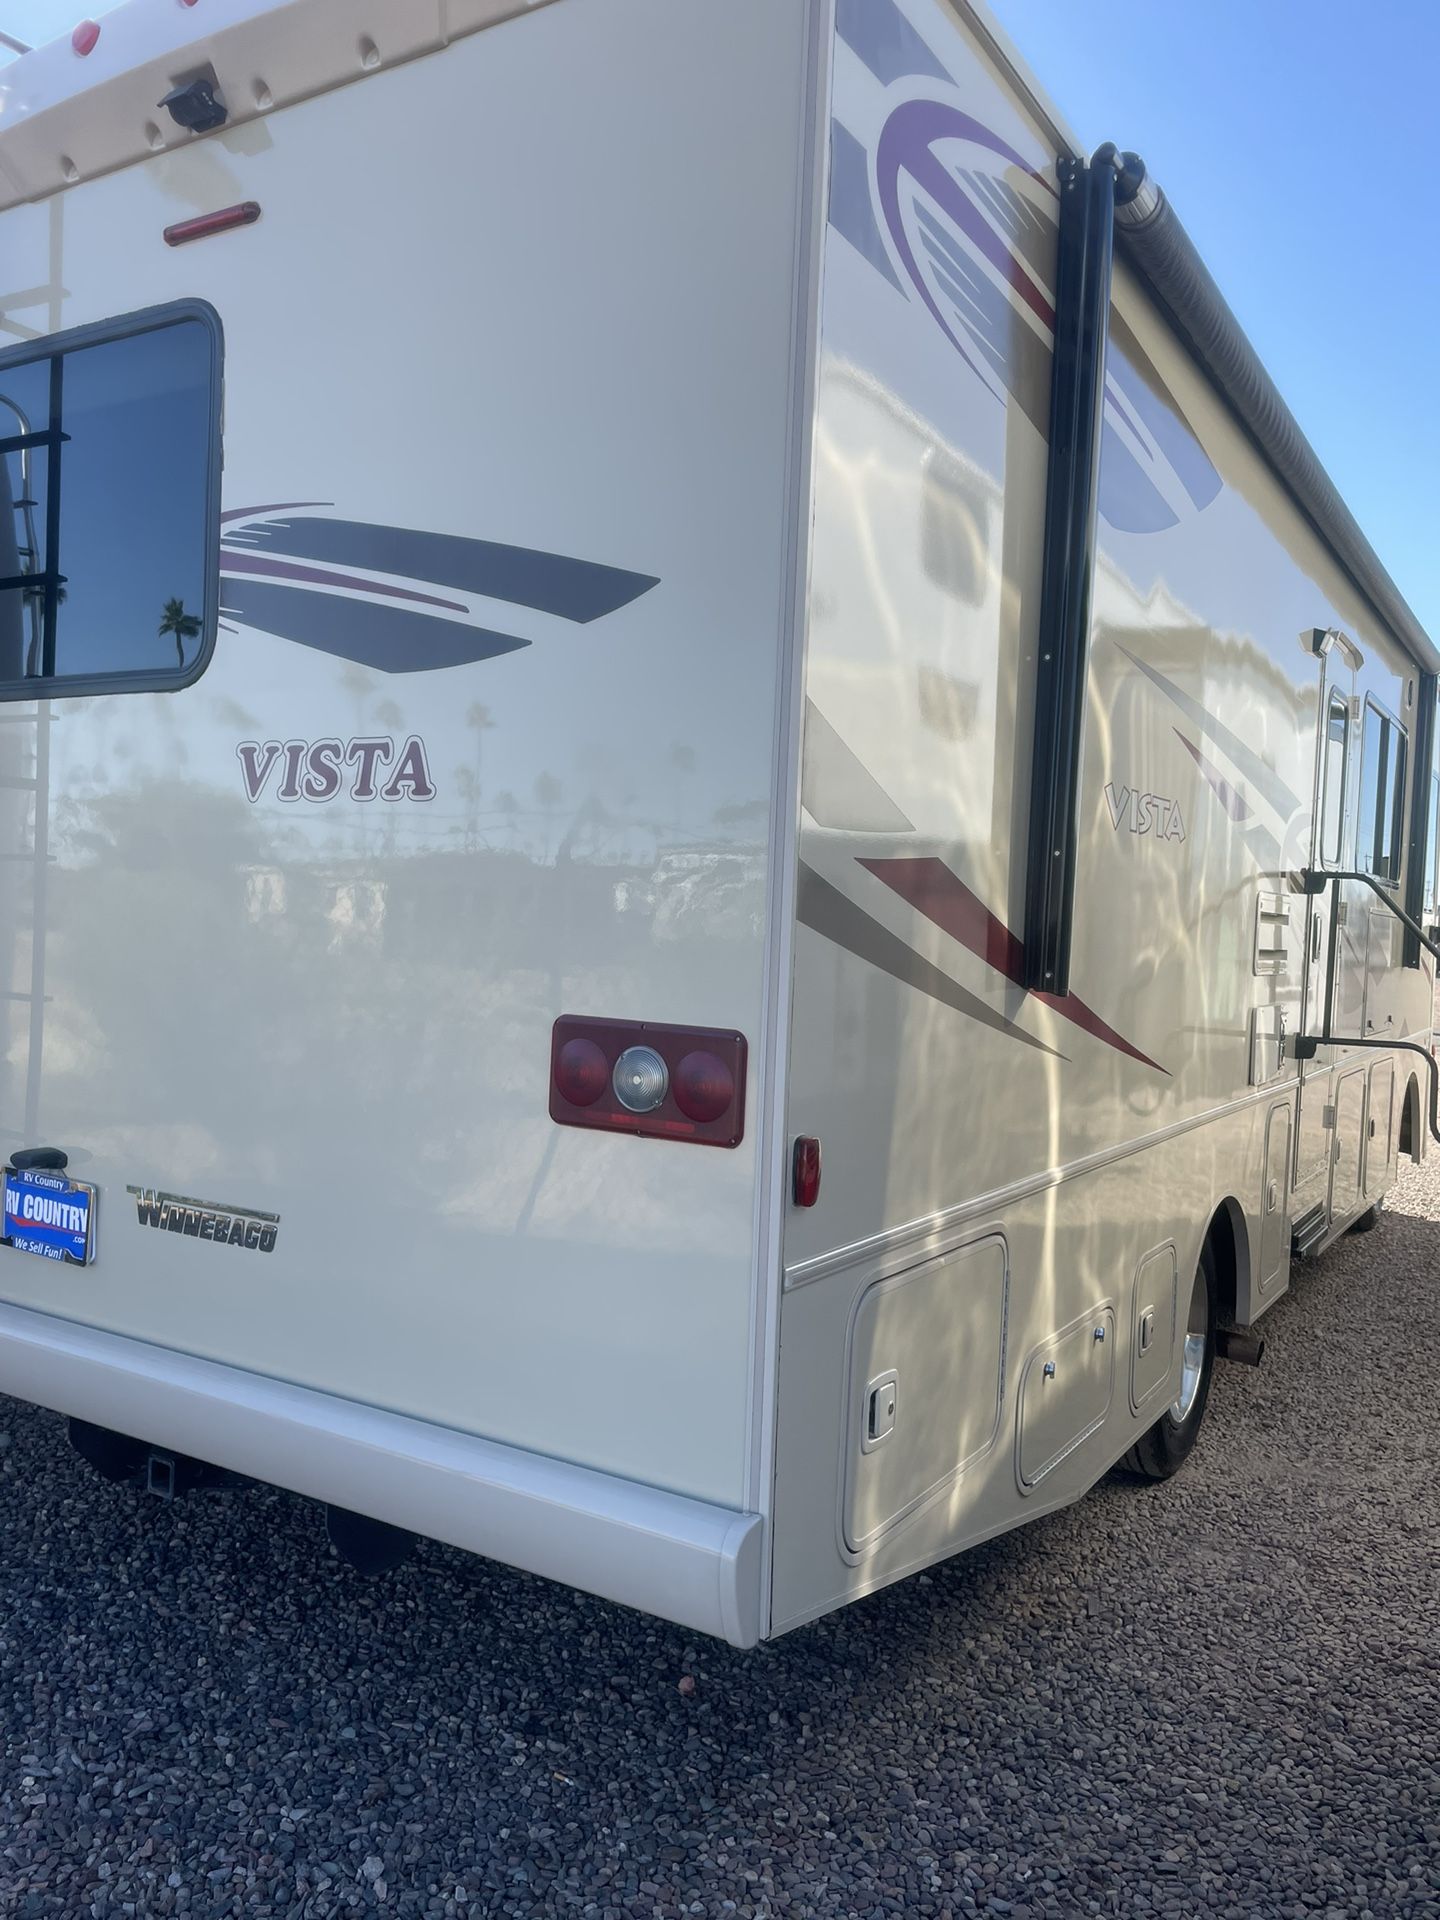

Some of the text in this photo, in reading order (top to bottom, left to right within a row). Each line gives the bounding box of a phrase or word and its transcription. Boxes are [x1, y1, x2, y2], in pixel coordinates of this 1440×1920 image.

[236, 735, 437, 803] VISTA
[1104, 782, 1186, 843] VISTA
[24, 1172, 65, 1192] RV Country
[5, 1188, 88, 1233] RV COUNTRY
[15, 1237, 63, 1260] We Sell Fun!
